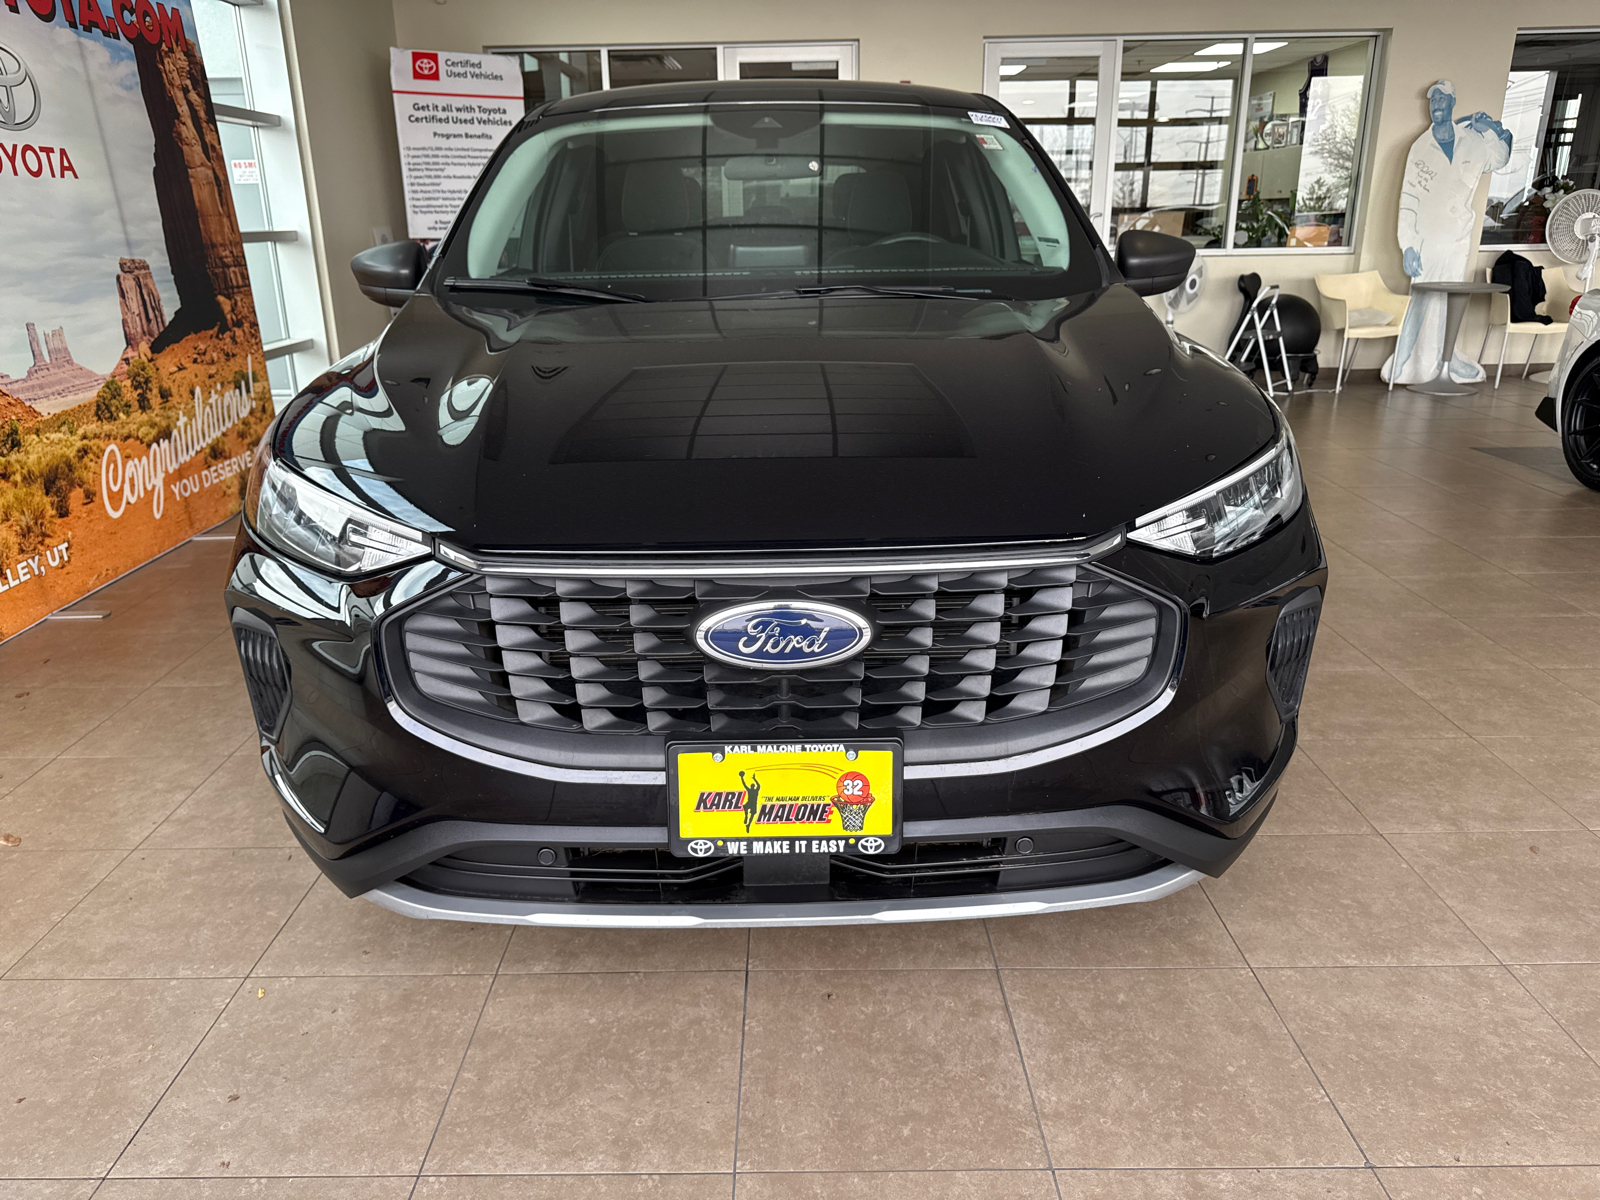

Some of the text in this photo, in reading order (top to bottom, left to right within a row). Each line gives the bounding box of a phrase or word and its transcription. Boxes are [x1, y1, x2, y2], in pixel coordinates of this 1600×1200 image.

[445, 59, 482, 69] Certified
[445, 69, 503, 81] Used Vehicles
[412, 102, 507, 116] Get it all with Toyota
[408, 114, 512, 126] Certified Used Vehicles
[433, 132, 492, 140] Program Benefits
[0, 142, 79, 180] YOTA
[101, 354, 257, 519] Congratulations!
[170, 450, 253, 501] YOU DESERVE
[46, 542, 69, 567] UT
[738, 617, 830, 654] Ford
[725, 744, 846, 754] KARL MALONE TOYOTA
[843, 780, 863, 796] 32
[694, 790, 747, 812] KARL
[756, 802, 834, 824] MALONE
[726, 840, 845, 854] WE MAKE IT EASY
